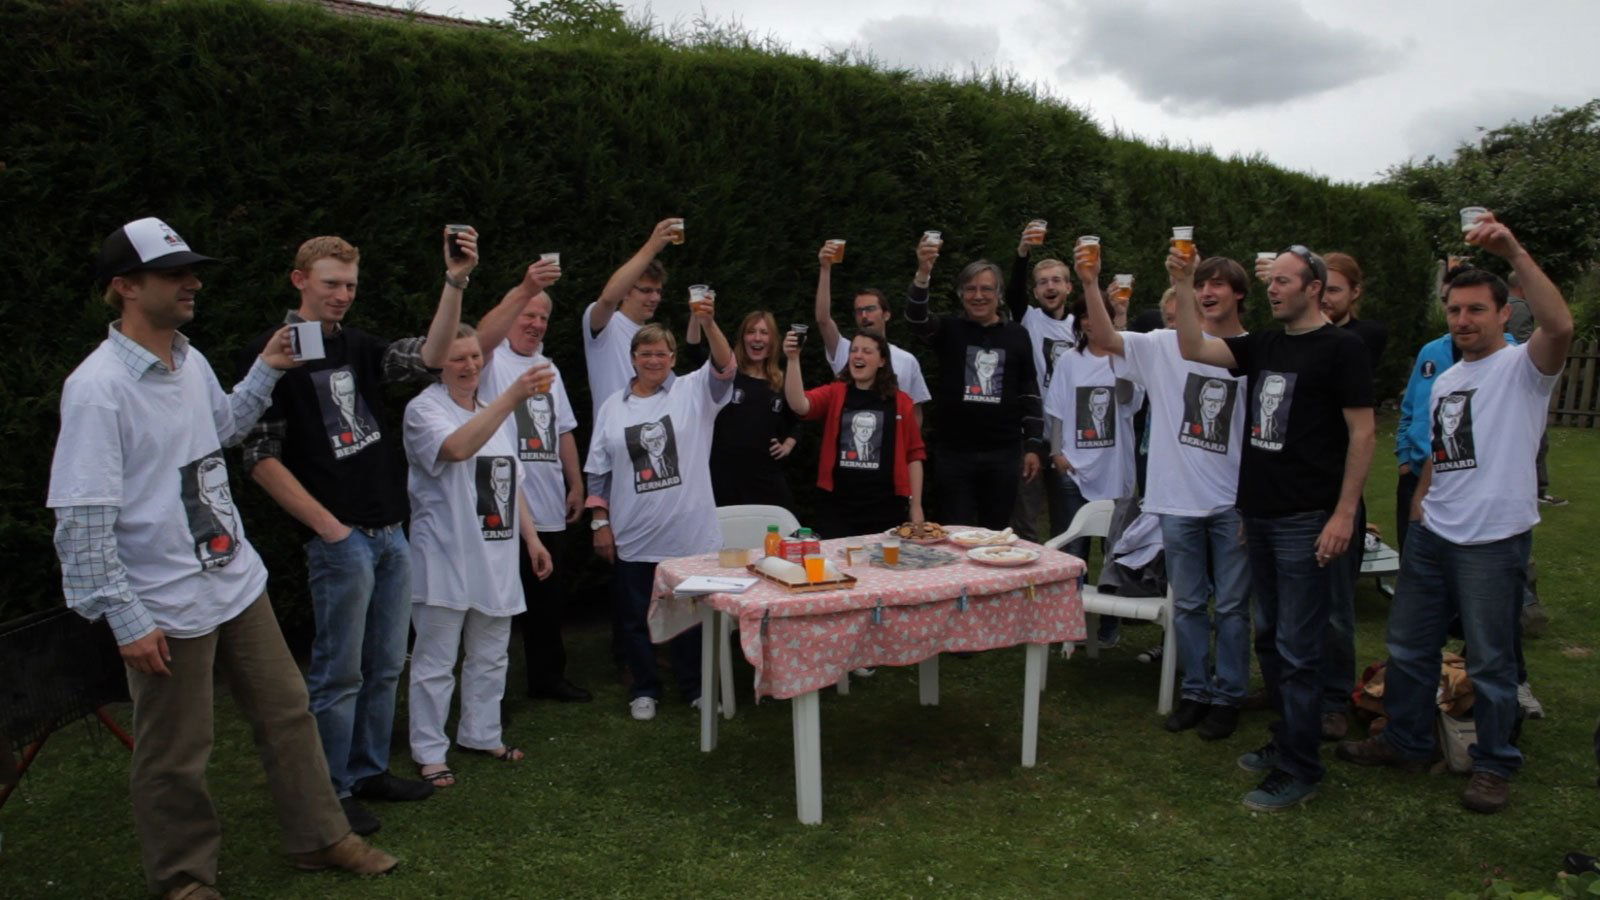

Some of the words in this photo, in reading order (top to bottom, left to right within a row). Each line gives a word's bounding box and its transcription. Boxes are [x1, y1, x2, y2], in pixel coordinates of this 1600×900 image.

[965, 385, 971, 394] I
[1182, 421, 1191, 434] I
[1077, 429, 1083, 440] I
[332, 434, 343, 447] I
[520, 438, 527, 450] I
[841, 451, 847, 460] I
[839, 460, 880, 470] BERNARD
[198, 541, 211, 561] I
